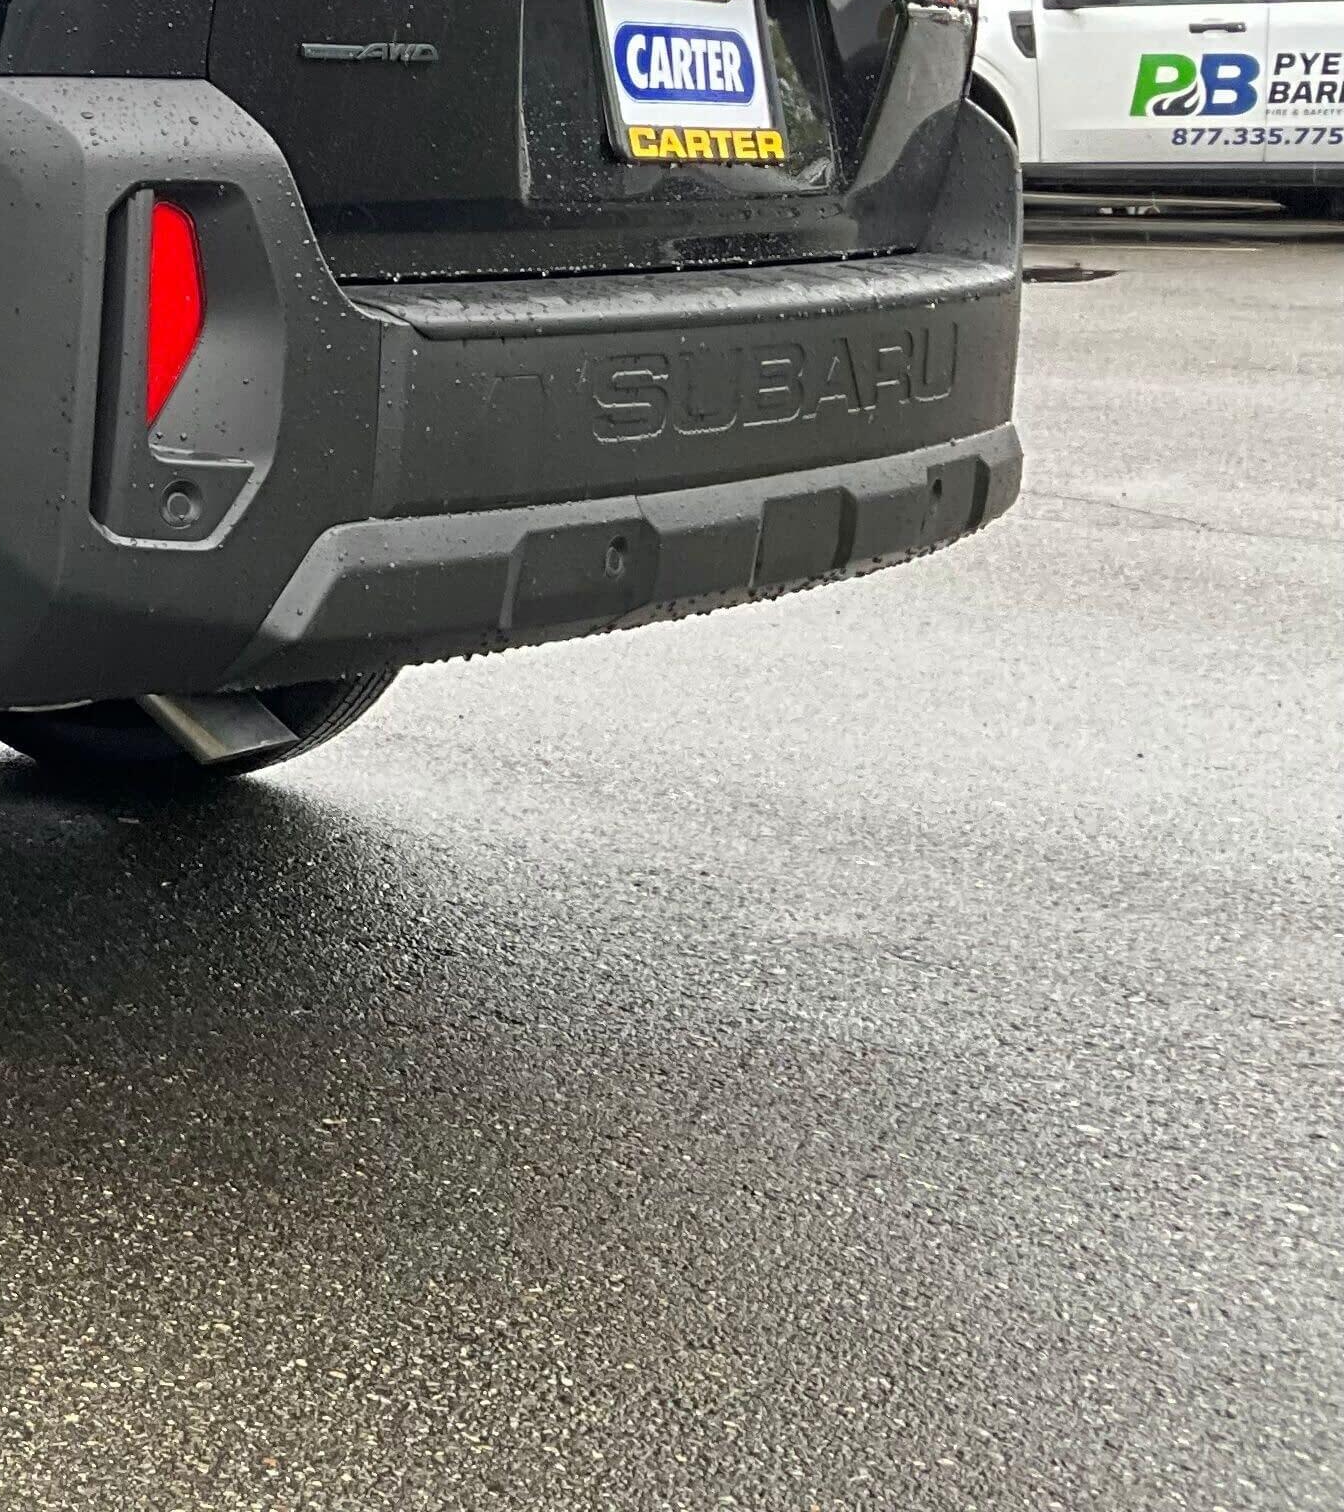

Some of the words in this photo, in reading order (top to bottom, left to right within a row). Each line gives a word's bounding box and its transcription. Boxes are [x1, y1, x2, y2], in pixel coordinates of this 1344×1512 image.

[626, 33, 745, 93] CARTER
[1273, 52, 1341, 76] PYE
[1267, 81, 1344, 104] BAR
[628, 126, 785, 160] CARTER
[591, 320, 958, 444] SUBARU
